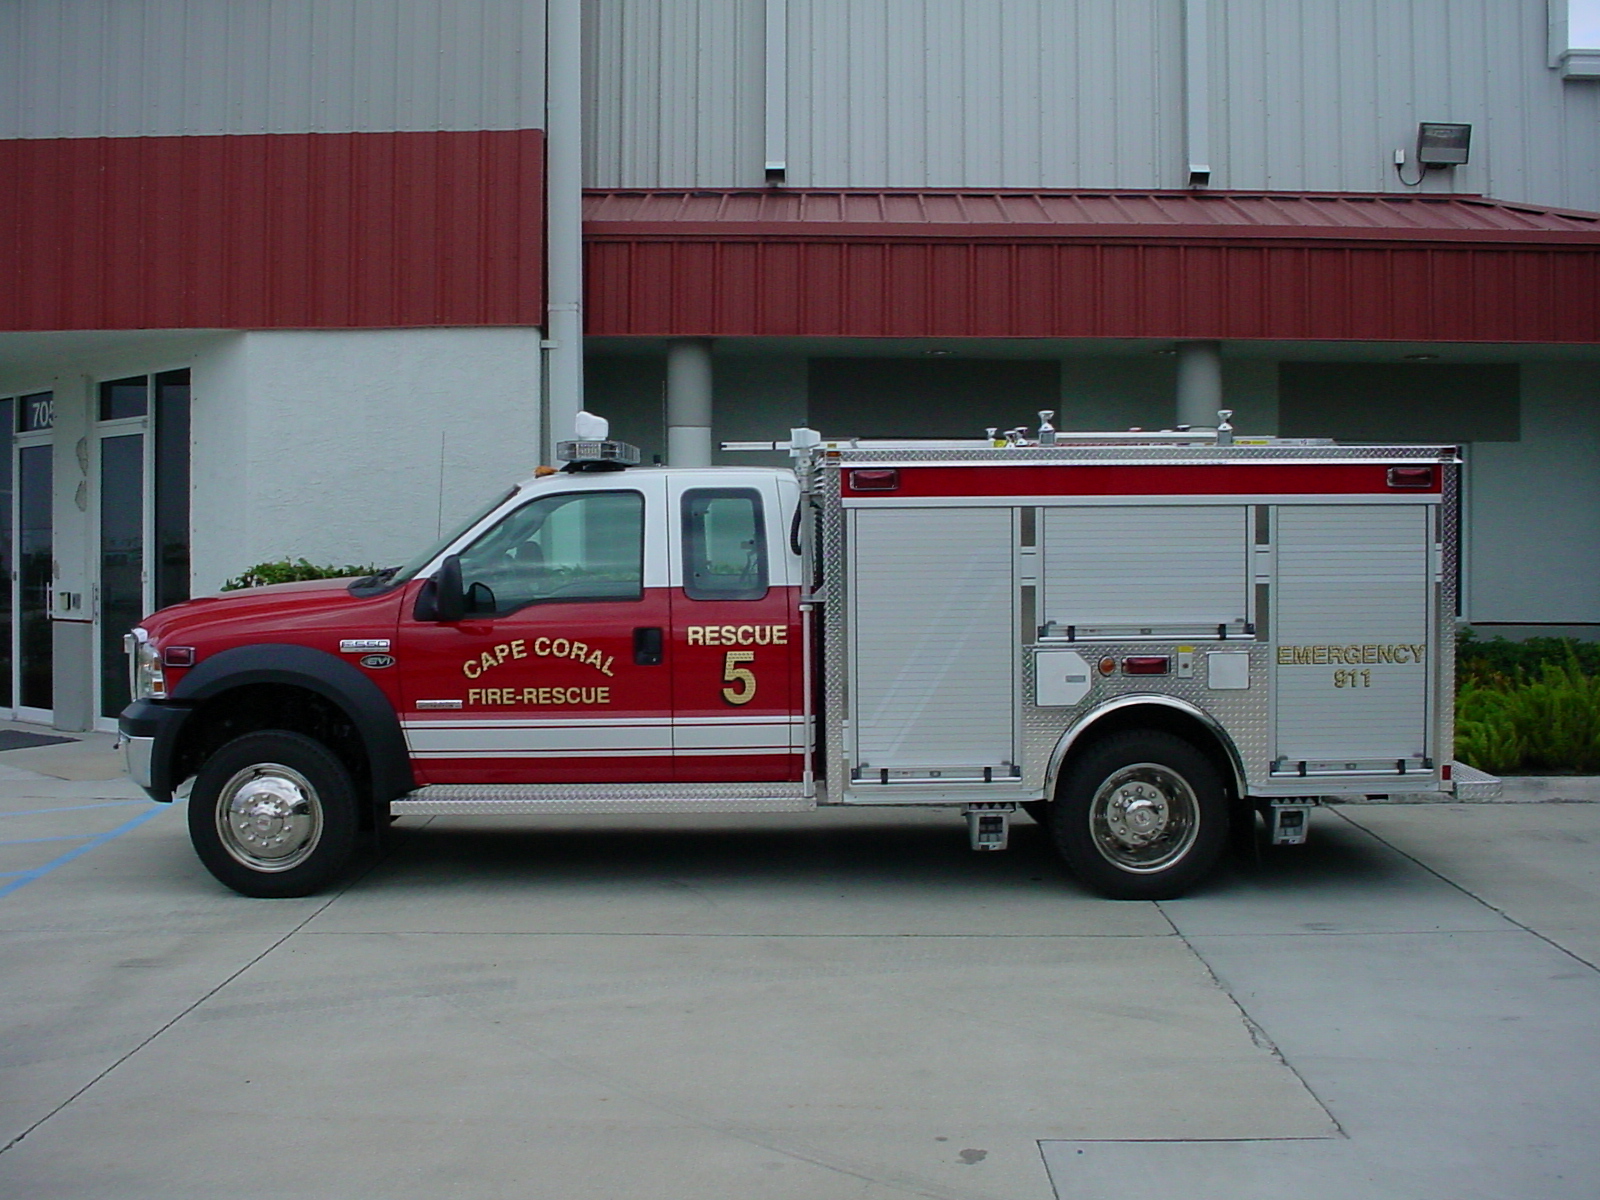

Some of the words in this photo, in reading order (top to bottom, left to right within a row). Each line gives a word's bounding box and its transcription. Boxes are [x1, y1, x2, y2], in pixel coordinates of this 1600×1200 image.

[687, 625, 788, 645] RESCUE
[462, 638, 528, 679] CAPE
[534, 637, 615, 678] CORAL
[1278, 645, 1425, 664] EMERGENCY
[722, 651, 756, 705] 5
[1334, 668, 1371, 688] 911
[468, 687, 611, 705] FIRE-RESCUE
